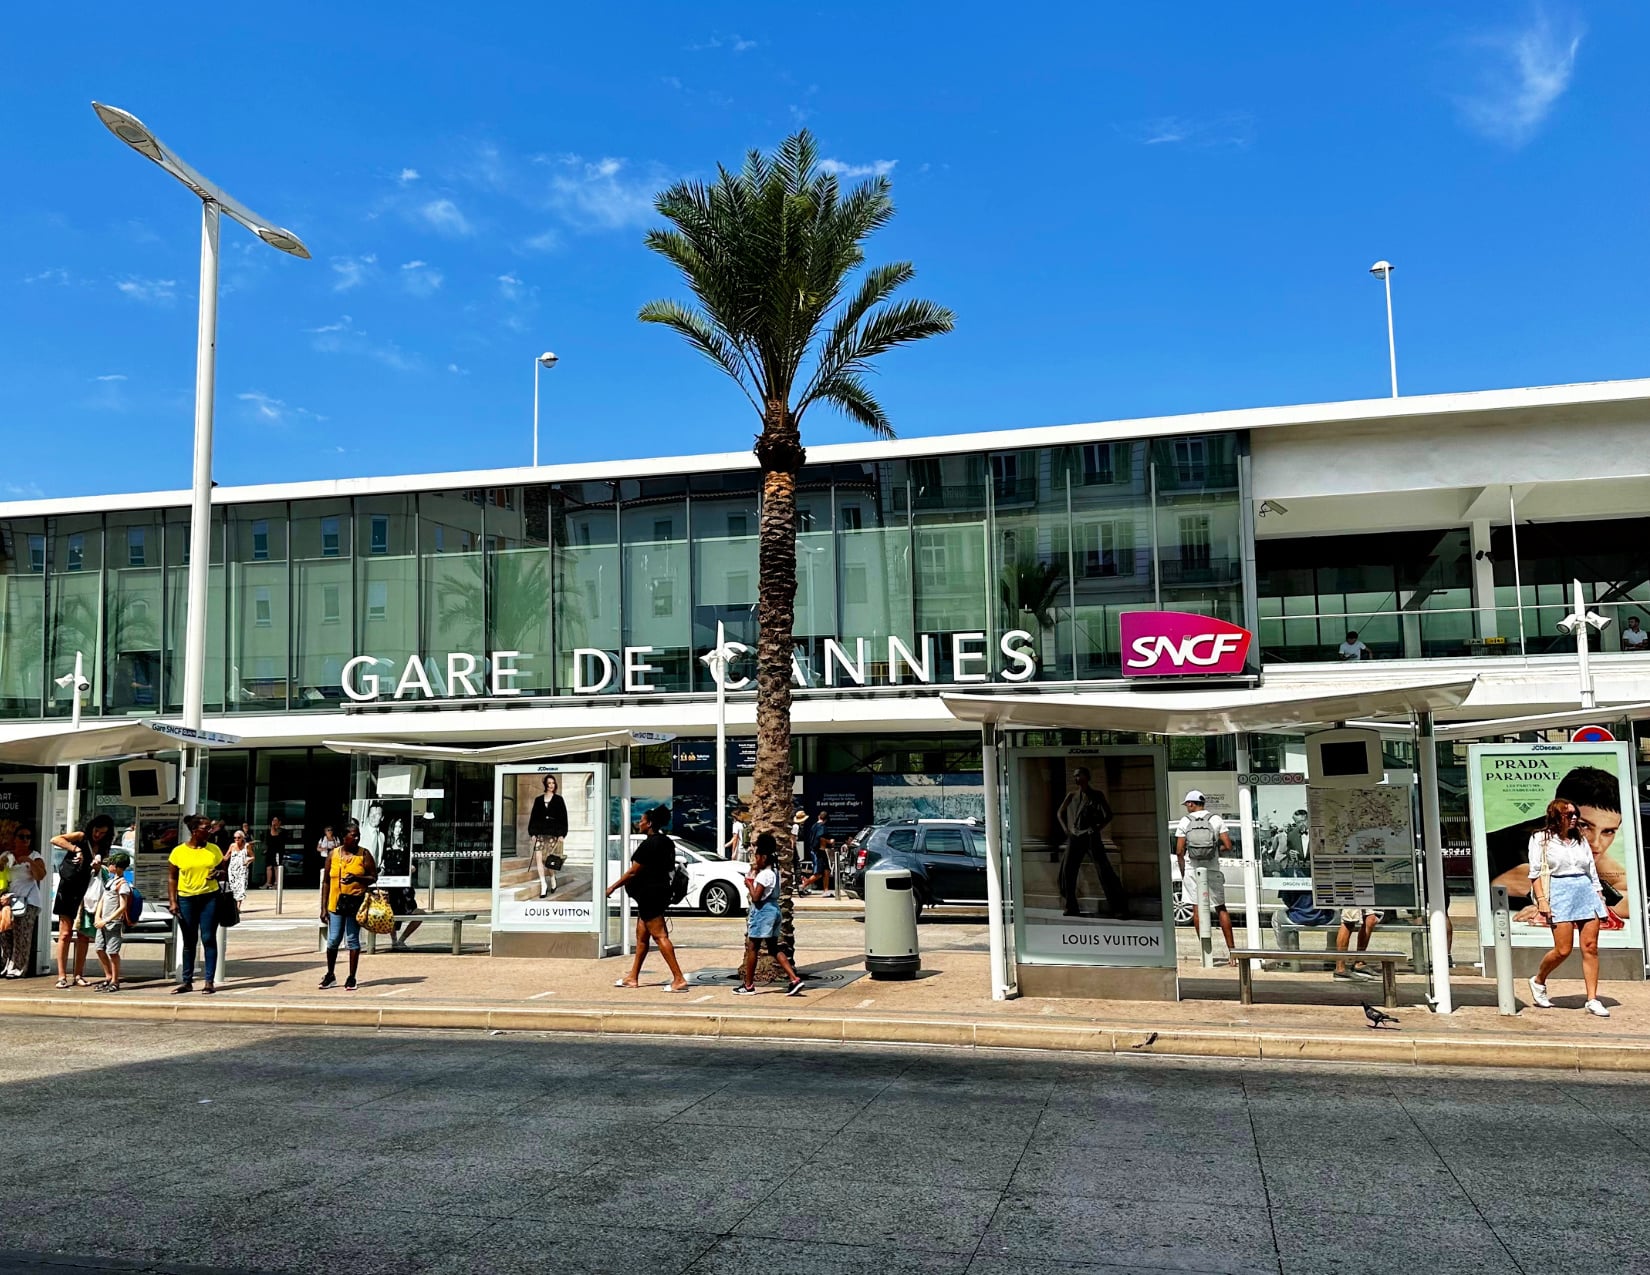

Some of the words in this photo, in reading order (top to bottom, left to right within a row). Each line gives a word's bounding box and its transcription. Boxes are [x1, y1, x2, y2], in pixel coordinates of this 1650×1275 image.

[1127, 633, 1243, 668] SNCF
[341, 650, 521, 701] GARE
[573, 645, 655, 693] DE
[166, 725, 182, 735] SNCF
[1495, 759, 1549, 769] PRADA
[1486, 772, 1561, 781] PARADOXE
[0, 802, 20, 810] IQUE
[525, 908, 550, 917] LOUIS
[552, 908, 590, 917] VUITTON
[1062, 934, 1100, 945] LOUIS
[1103, 935, 1159, 947] VUITTON
